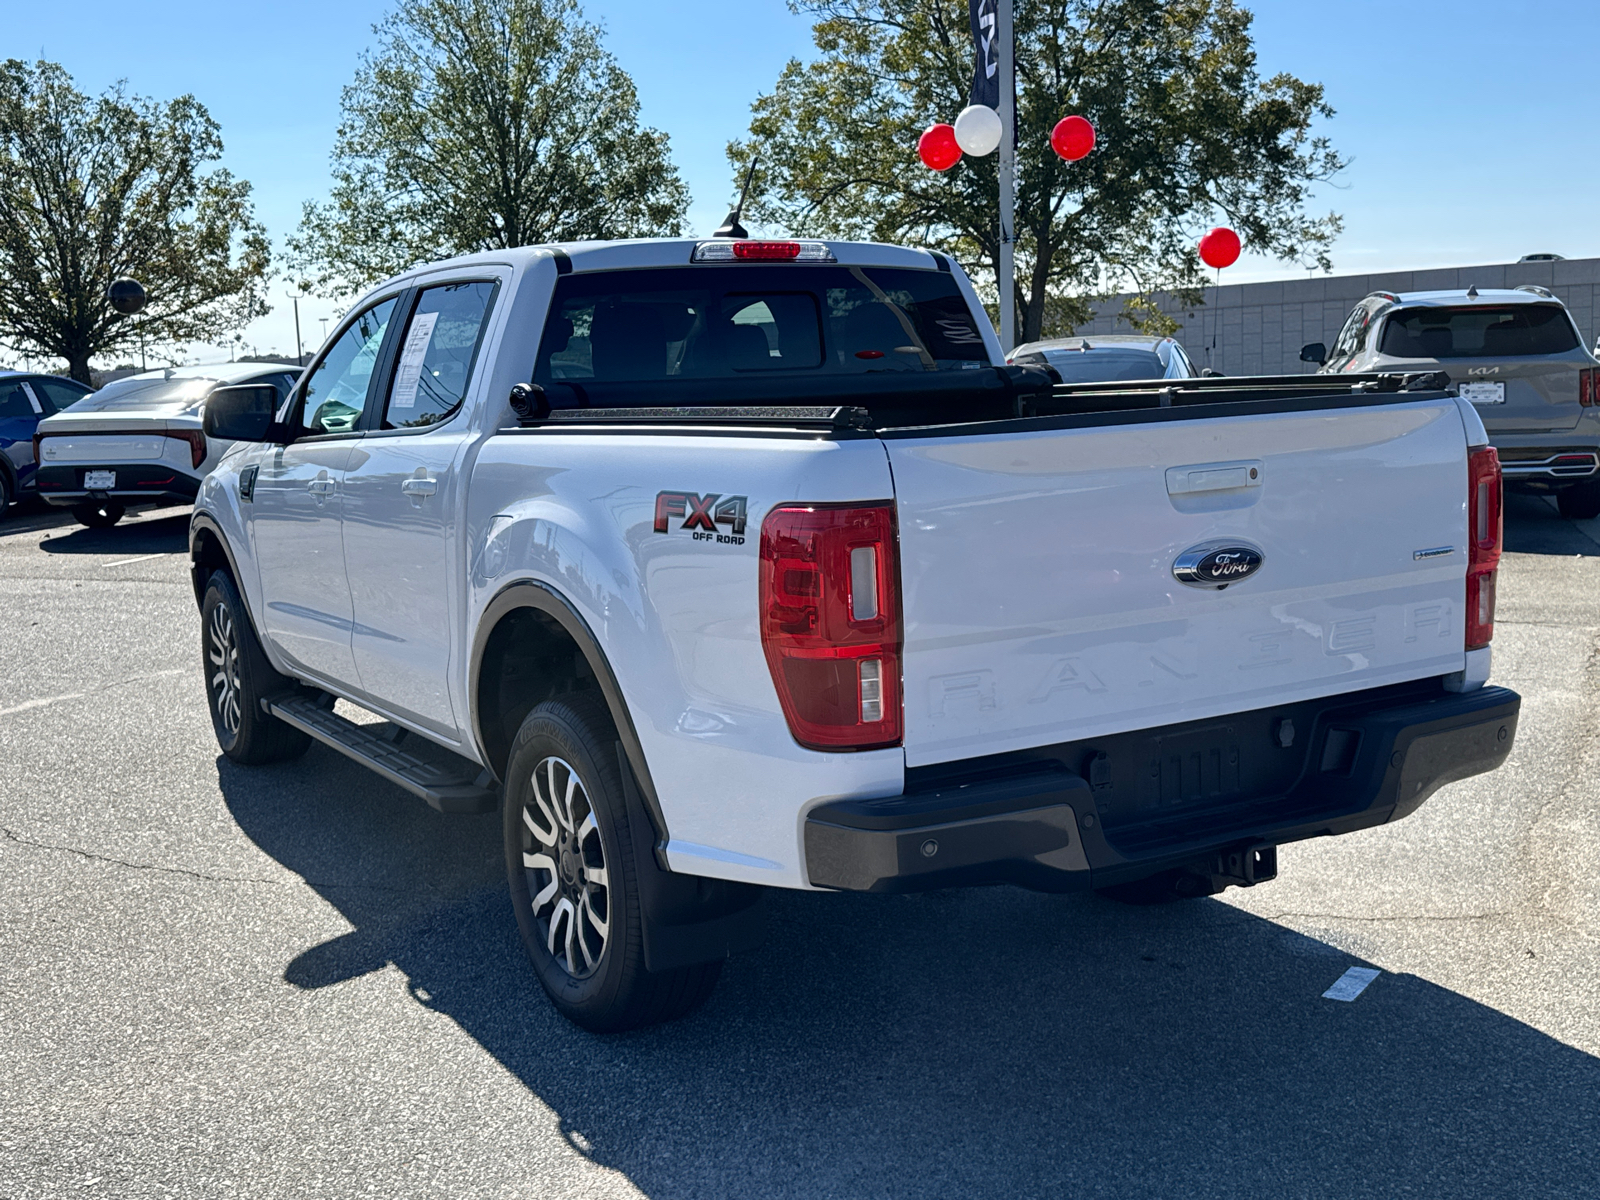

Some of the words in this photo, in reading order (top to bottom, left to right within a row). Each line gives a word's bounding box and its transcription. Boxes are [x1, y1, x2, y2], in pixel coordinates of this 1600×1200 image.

[1467, 366, 1499, 375] KIA
[653, 490, 748, 536] FX4
[692, 531, 713, 542] OFF
[716, 534, 745, 545] ROAD
[1211, 552, 1250, 576] Ford
[927, 597, 1454, 719] RANGER
[520, 721, 579, 758] IRONMAN
